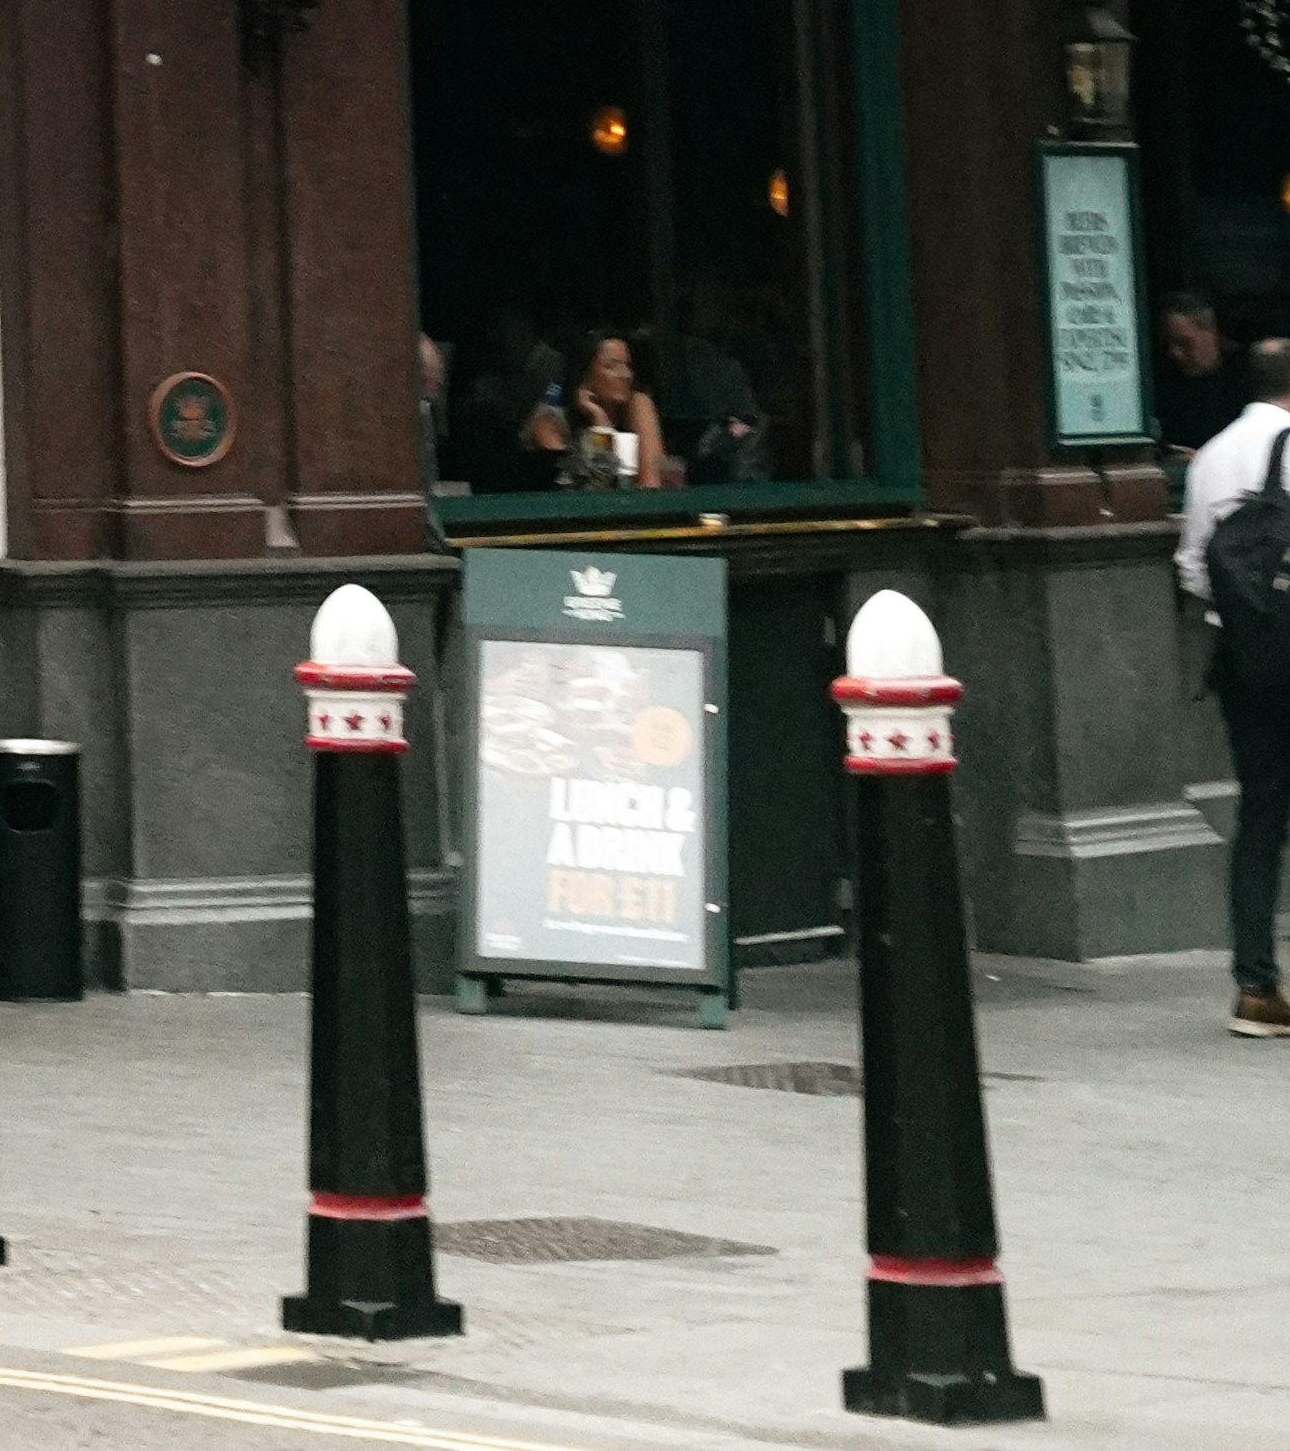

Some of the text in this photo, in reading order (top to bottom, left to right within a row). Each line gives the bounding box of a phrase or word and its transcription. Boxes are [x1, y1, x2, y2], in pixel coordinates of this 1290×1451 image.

[549, 777, 696, 833] LUNCH &
[546, 822, 685, 876] A DRINK
[548, 869, 615, 916] FOR
